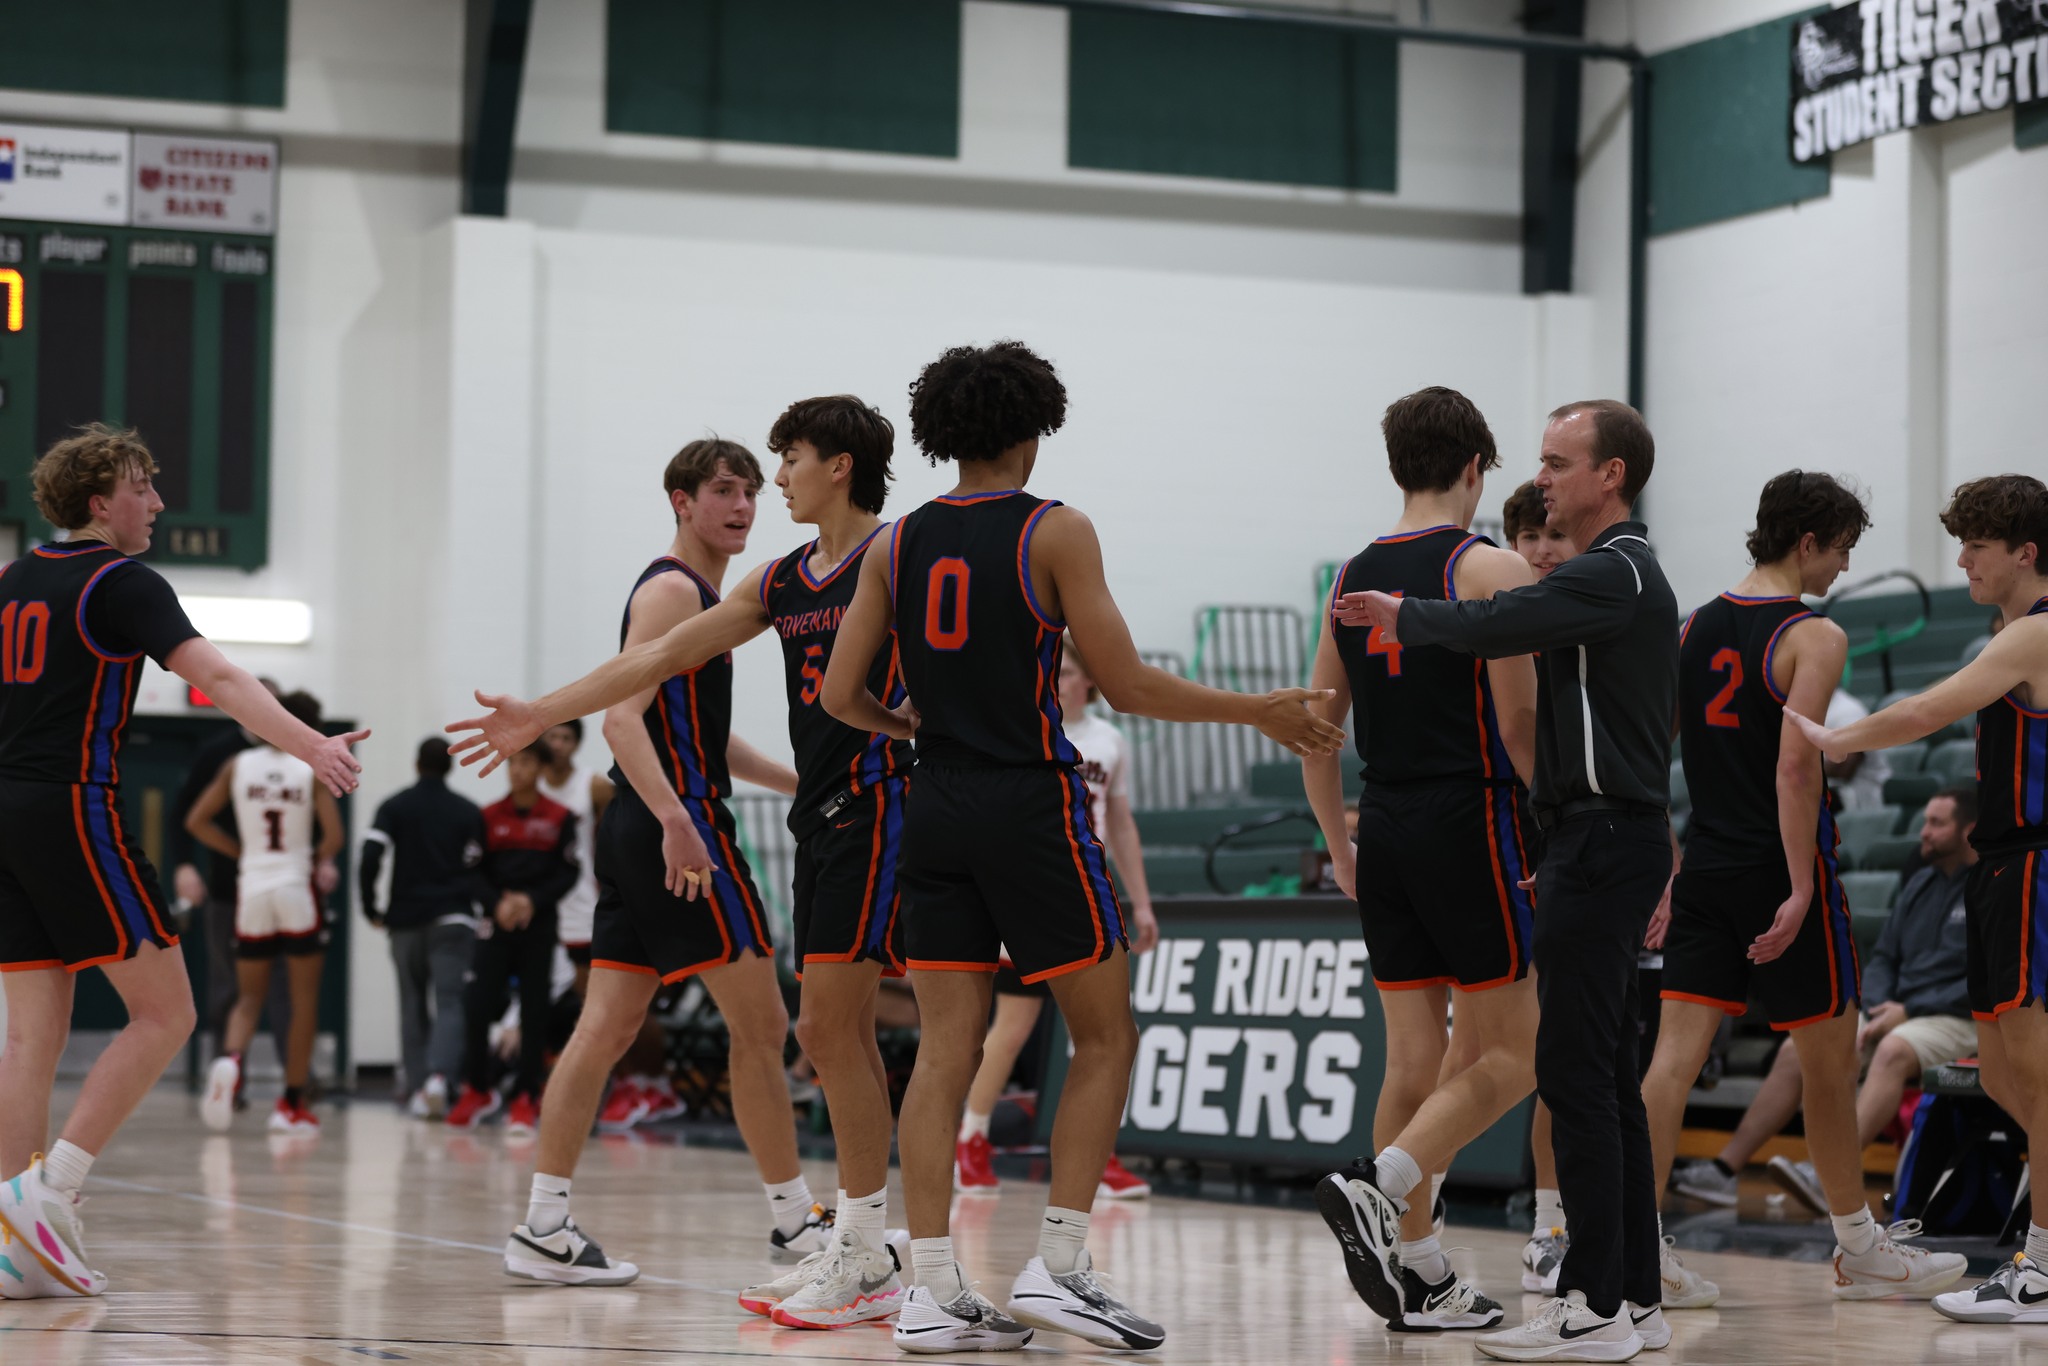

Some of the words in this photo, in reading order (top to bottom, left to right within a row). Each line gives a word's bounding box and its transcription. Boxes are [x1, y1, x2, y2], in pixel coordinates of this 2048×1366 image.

[1793, 63, 1923, 162] STUDENT
[23, 144, 120, 166] Independent
[23, 163, 61, 179] Bank
[166, 147, 269, 171] CITIZENS
[166, 172, 234, 195] STATE
[166, 196, 226, 219] BANK
[40, 229, 108, 266] player
[128, 240, 197, 270] points
[211, 242, 268, 275] fouls
[774, 605, 847, 639] COVENAN
[924, 556, 971, 651] 0
[0, 600, 50, 684] 10
[1366, 625, 1405, 678] 4
[800, 643, 824, 706] 5
[1703, 646, 1744, 729] 2
[262, 807, 287, 854] 1
[1129, 938, 1205, 1014] UE
[1212, 939, 1370, 1019] RIDGE
[1120, 1024, 1362, 1144] GERS
